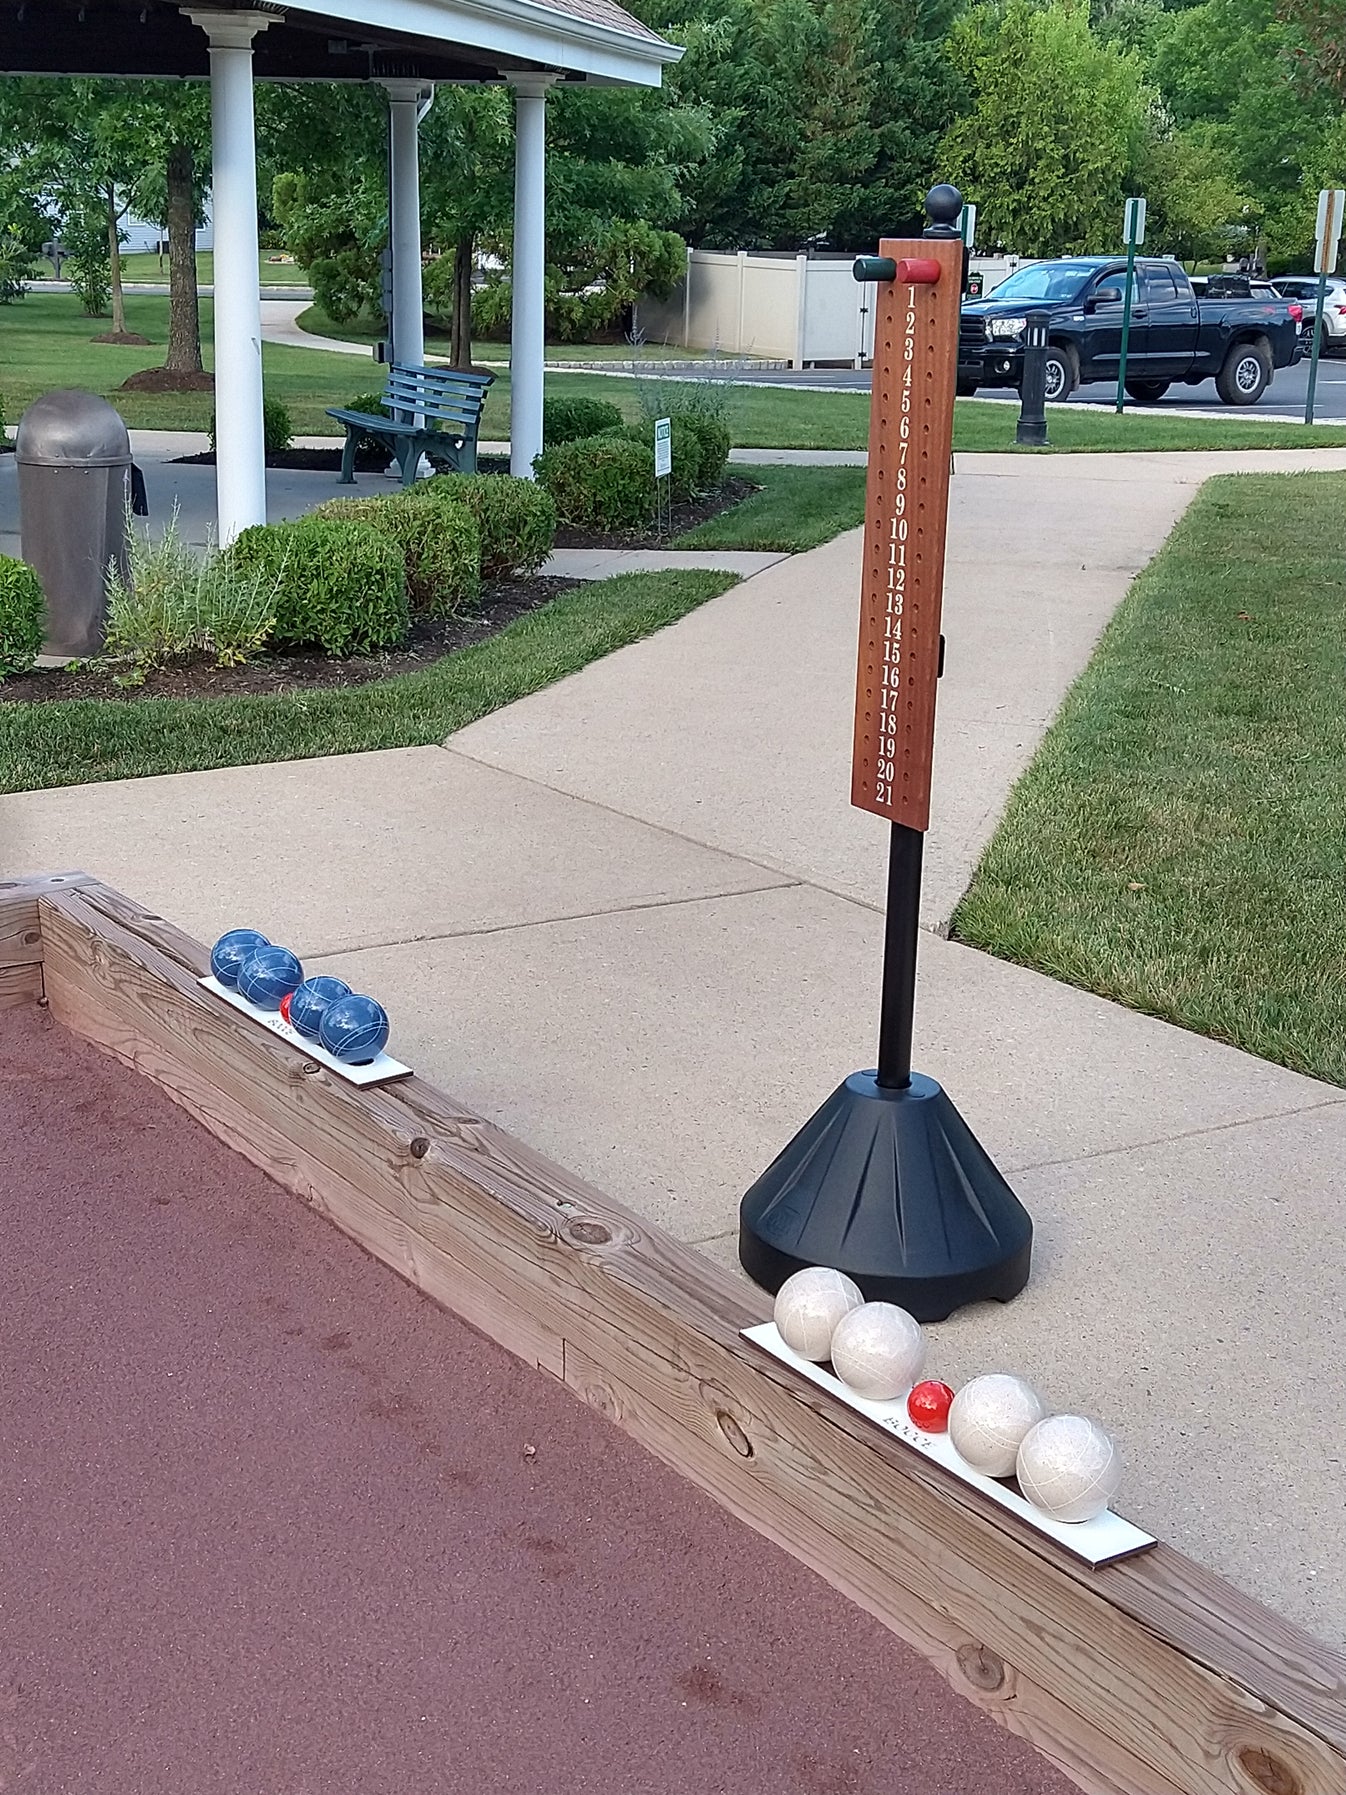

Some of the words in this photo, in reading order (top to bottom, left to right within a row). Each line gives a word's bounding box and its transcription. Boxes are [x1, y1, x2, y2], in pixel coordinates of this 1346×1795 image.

[907, 285, 916, 309] 1
[904, 311, 915, 335] 2
[903, 338, 914, 361] 3
[901, 364, 912, 387] 4
[901, 390, 911, 413] 5
[899, 416, 910, 439] 6
[898, 441, 909, 465] 7
[896, 467, 907, 491] 8
[895, 493, 905, 517] 9
[890, 517, 908, 541] 10
[888, 543, 906, 567] 11
[887, 567, 905, 592] 12
[885, 591, 904, 616] 13
[884, 615, 902, 641] 14
[882, 640, 901, 663] 15
[881, 664, 900, 688] 16
[880, 688, 899, 712] 17
[879, 711, 897, 736] 18
[877, 735, 896, 759] 19
[876, 758, 895, 783] 20
[875, 781, 893, 807] 21
